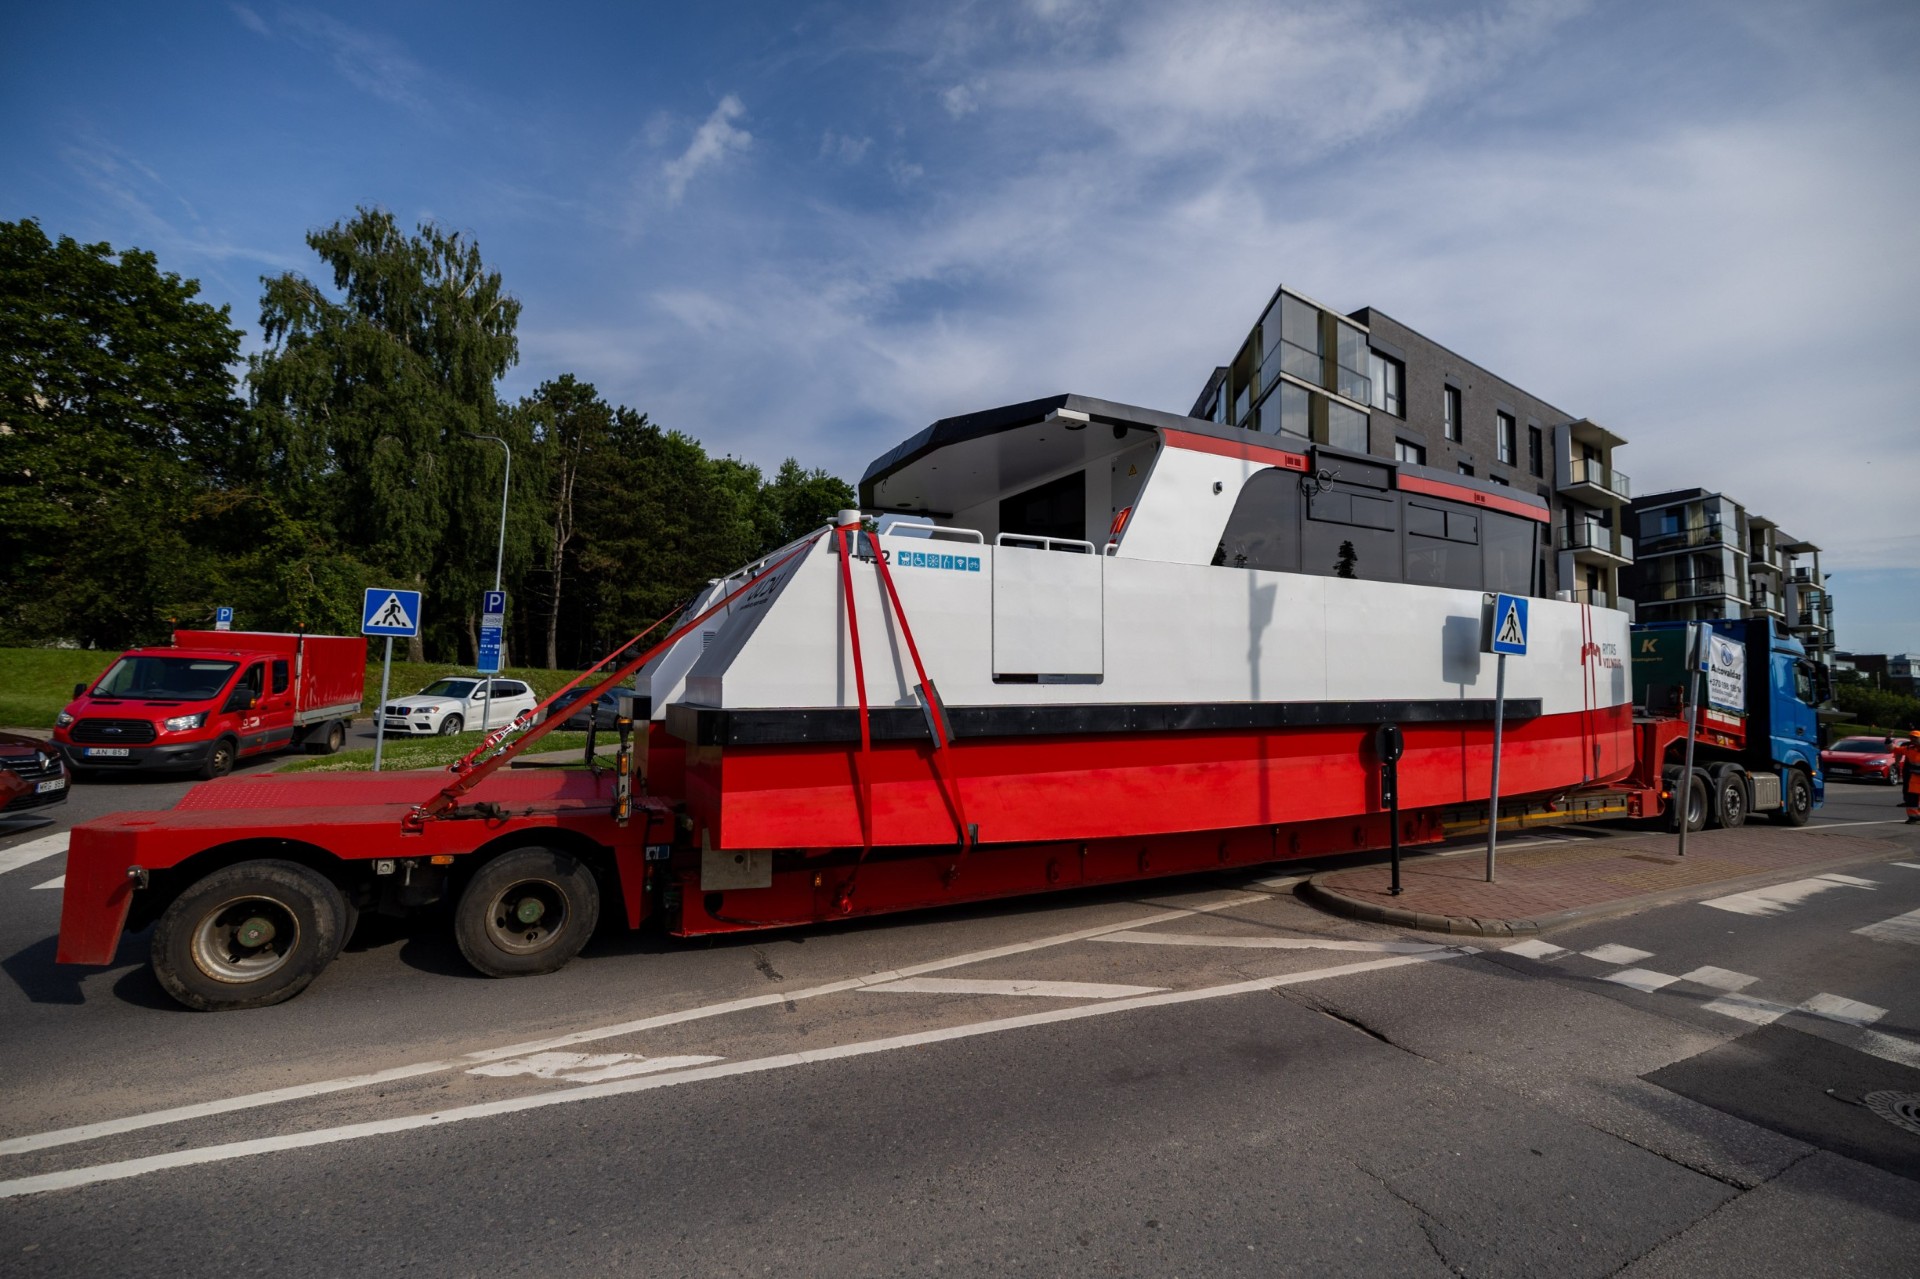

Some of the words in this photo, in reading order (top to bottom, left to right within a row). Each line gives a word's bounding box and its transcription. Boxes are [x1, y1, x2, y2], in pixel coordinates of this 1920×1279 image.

[489, 594, 501, 612] P
[220, 608, 230, 620] P
[1602, 643, 1616, 655] RYTAS
[1641, 639, 1657, 653] K
